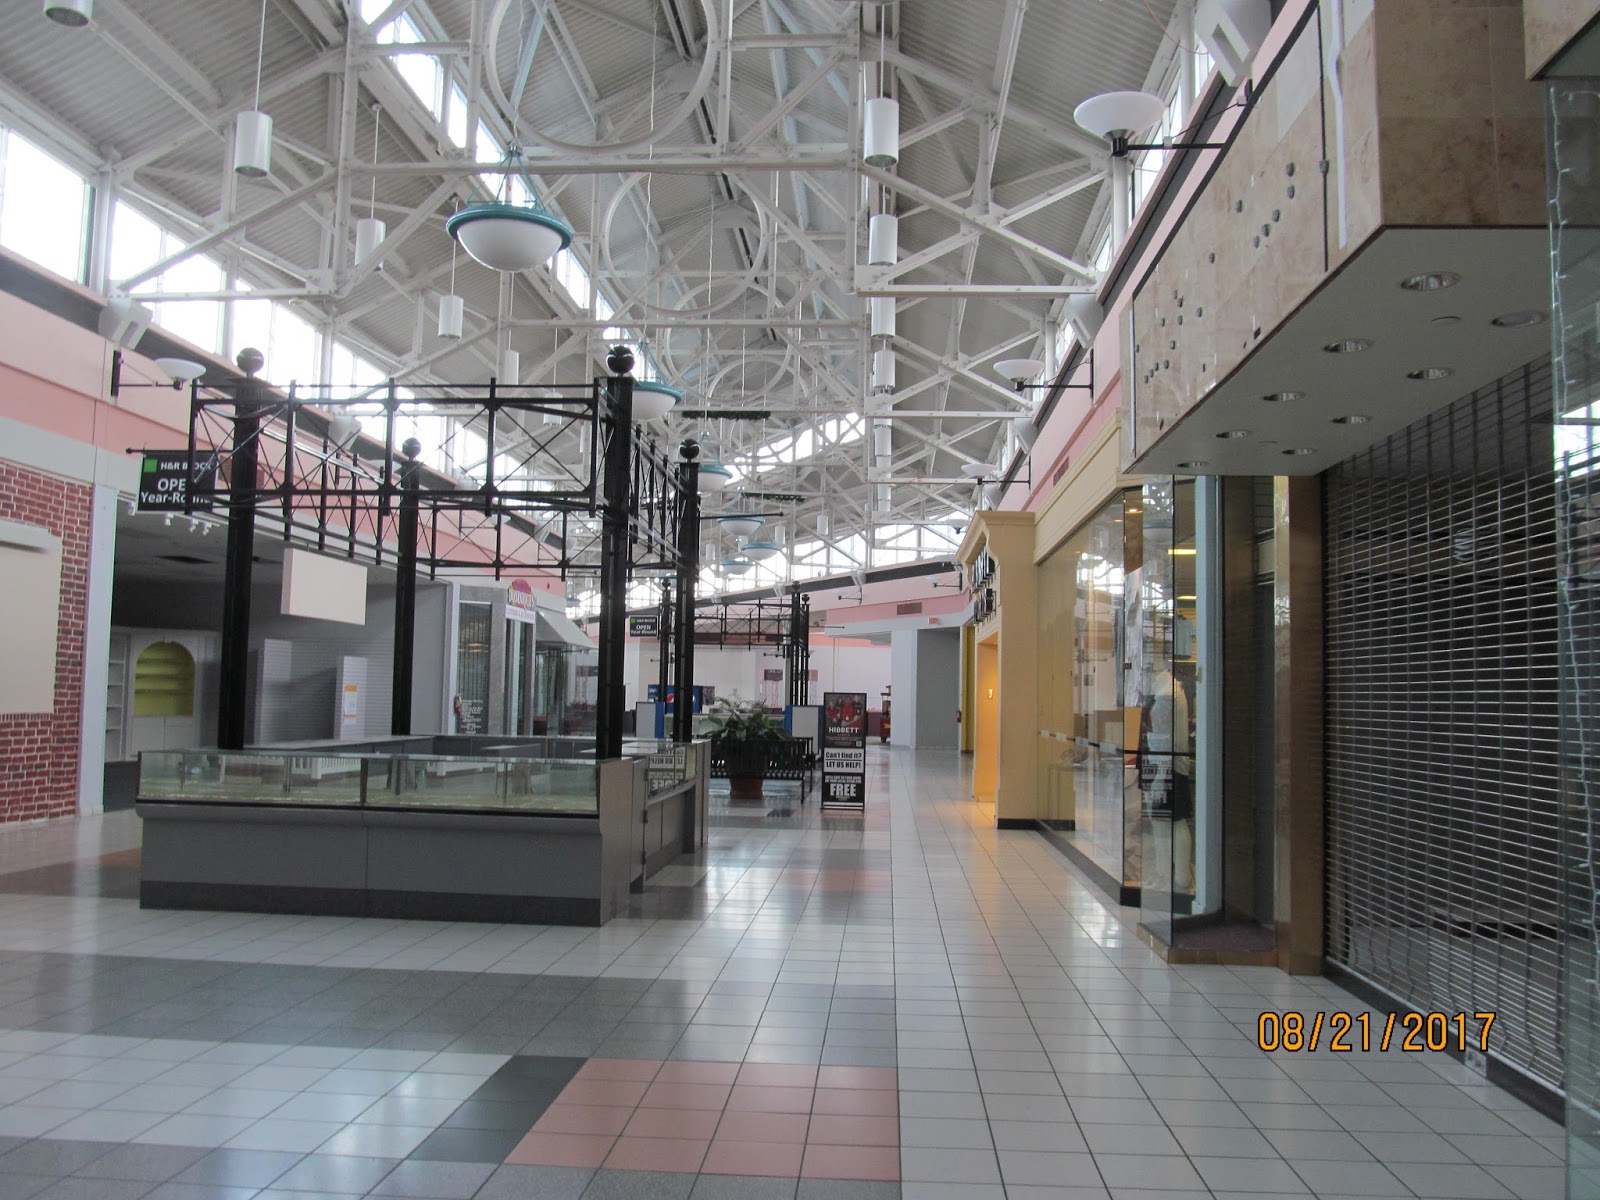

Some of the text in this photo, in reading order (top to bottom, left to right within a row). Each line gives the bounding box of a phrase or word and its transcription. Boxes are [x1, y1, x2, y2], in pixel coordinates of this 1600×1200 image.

[160, 461, 180, 470] H&R
[157, 477, 187, 492] OPE
[828, 726, 860, 734] HIBBETT
[825, 751, 841, 759] Can't
[830, 783, 857, 797] FREE
